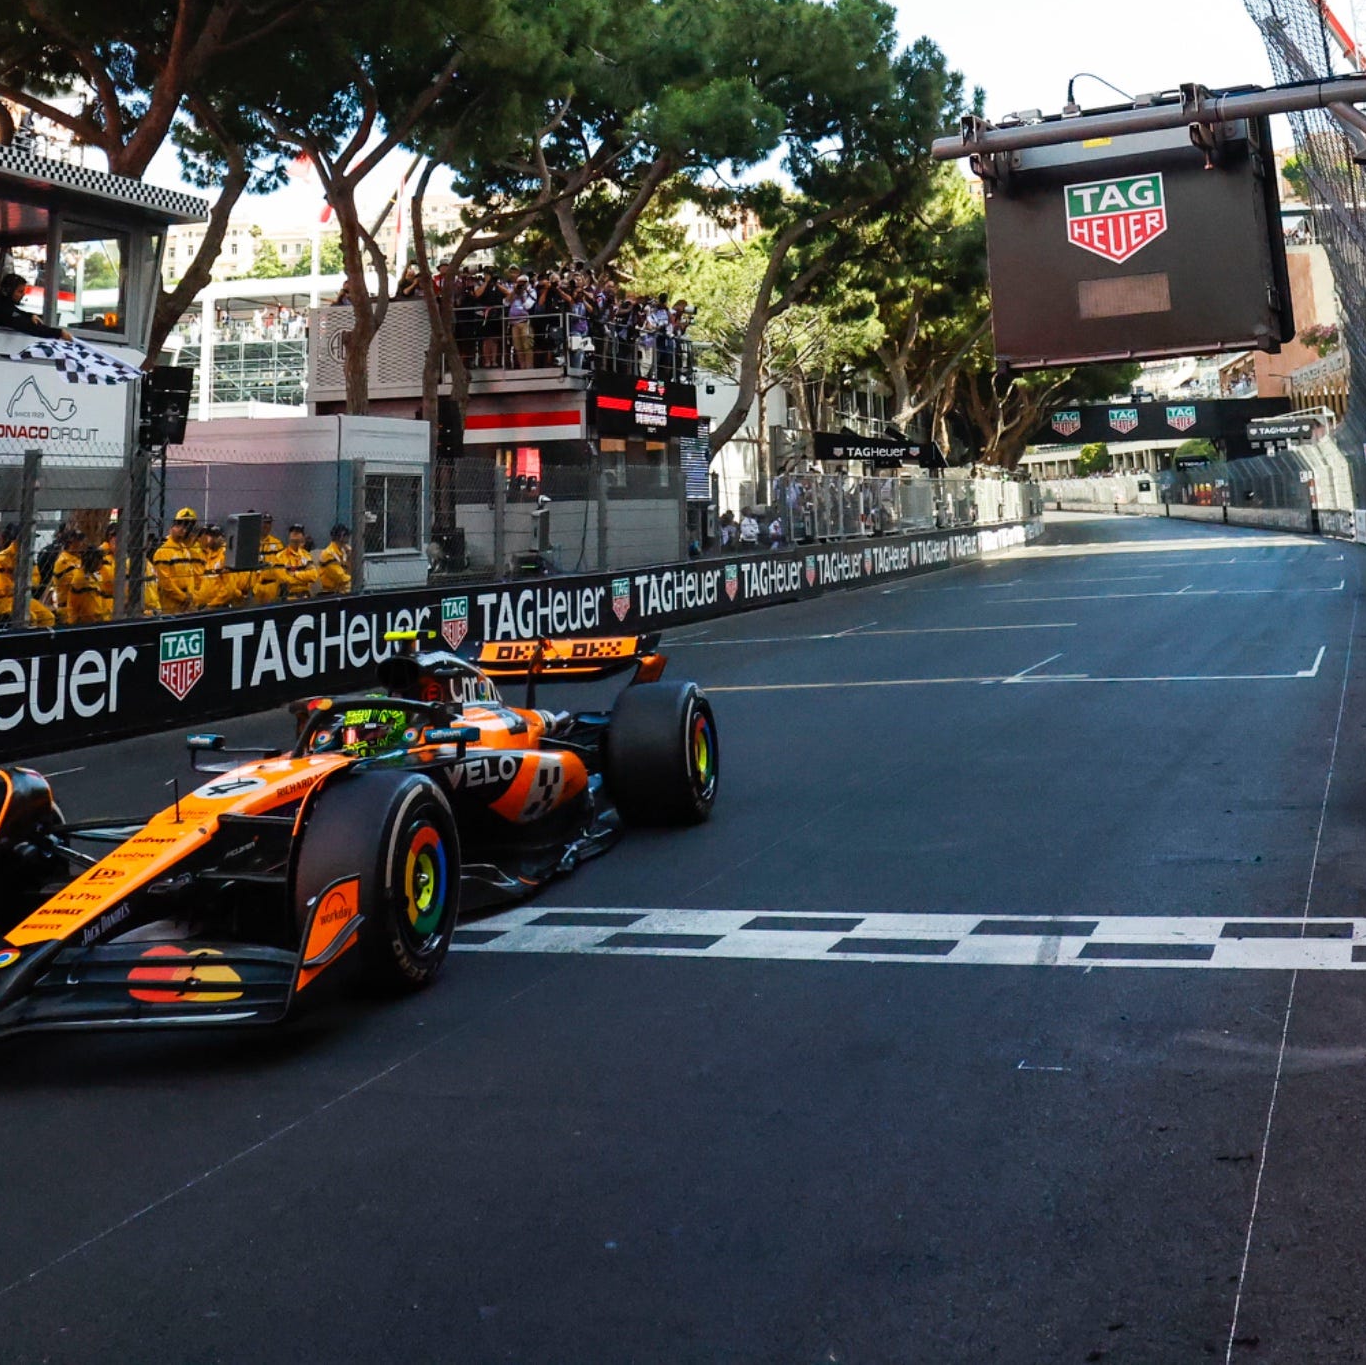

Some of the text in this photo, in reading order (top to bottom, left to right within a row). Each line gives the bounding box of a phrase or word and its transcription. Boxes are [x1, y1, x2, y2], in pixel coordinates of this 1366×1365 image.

[1073, 180, 1154, 213] TAG
[1073, 212, 1160, 256] HEUER
[1055, 413, 1078, 422] TAG
[1112, 409, 1136, 419] TAG
[1170, 407, 1193, 415] TAG
[444, 600, 466, 618] TAG
[164, 634, 202, 658] TAG
[572, 641, 622, 656] OKX
[161, 660, 202, 694] HEUER
[444, 755, 517, 790] VELO
[206, 779, 258, 797] 4
[276, 777, 313, 799] RICHARD
[320, 906, 353, 926] workday
